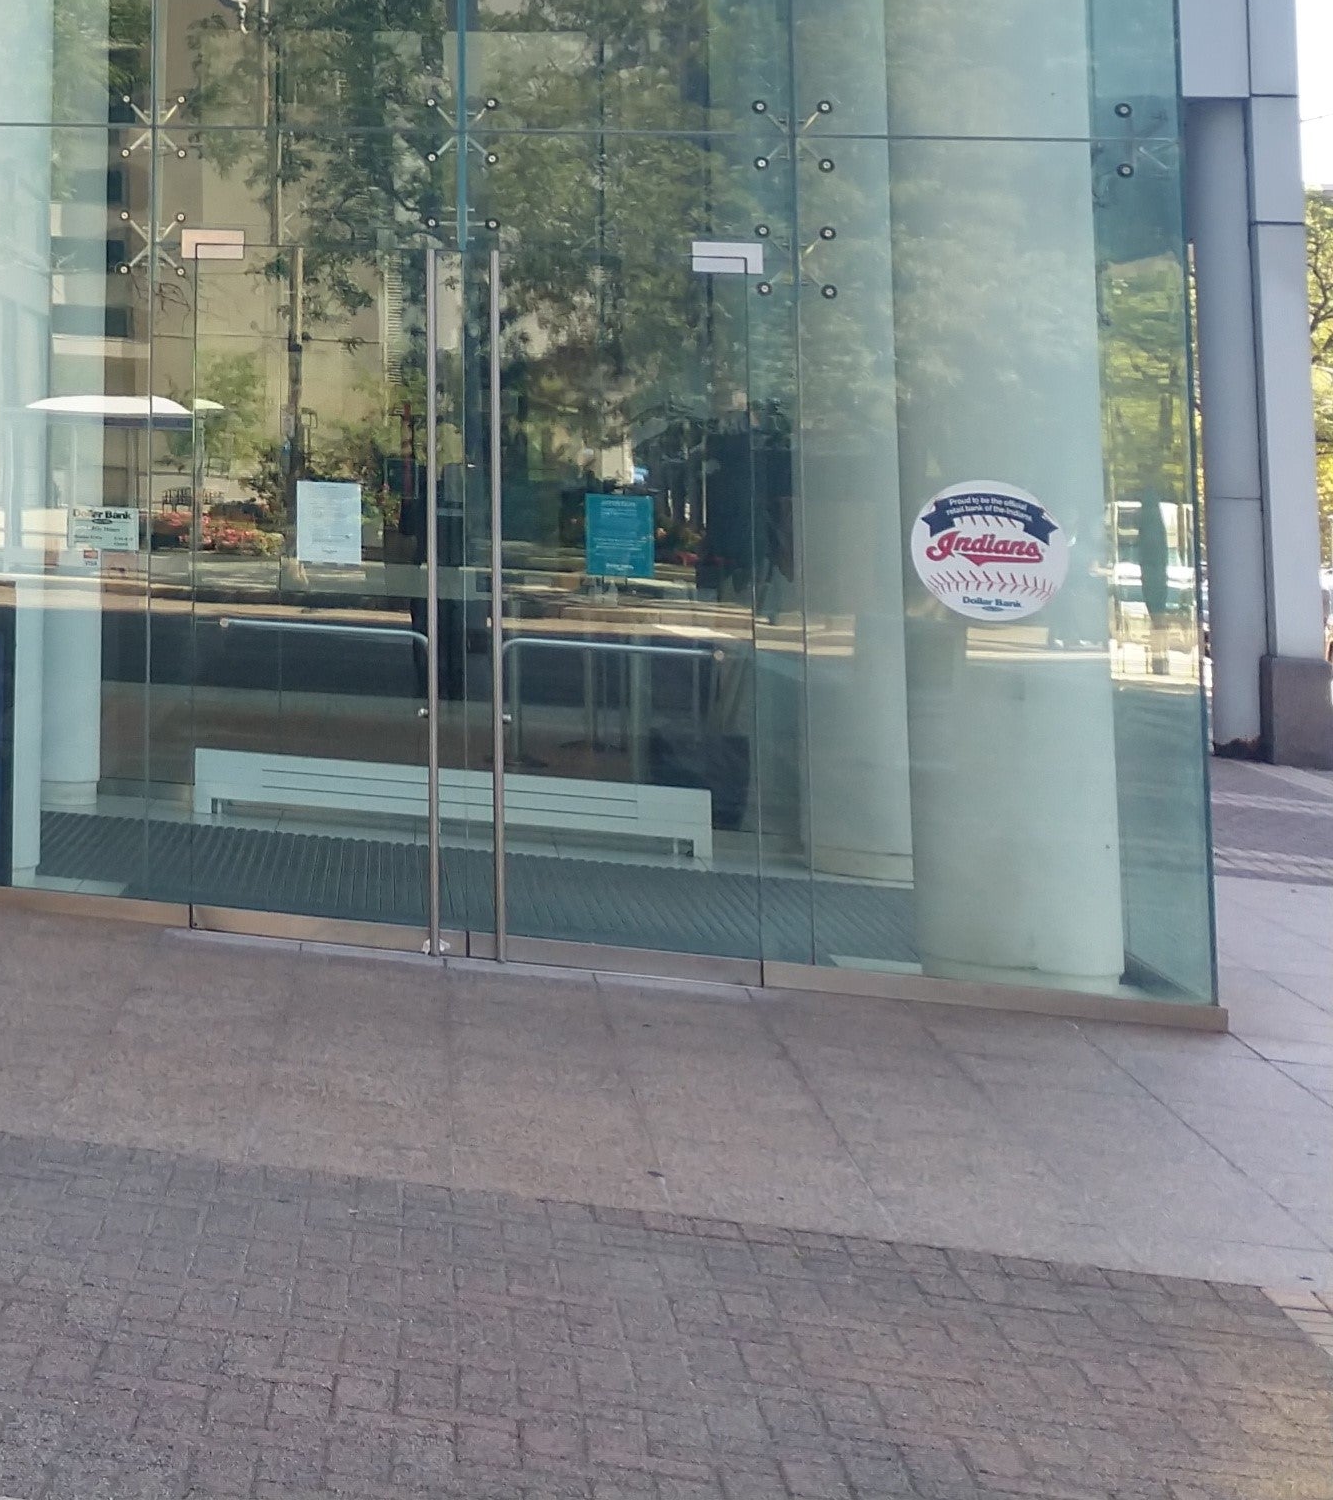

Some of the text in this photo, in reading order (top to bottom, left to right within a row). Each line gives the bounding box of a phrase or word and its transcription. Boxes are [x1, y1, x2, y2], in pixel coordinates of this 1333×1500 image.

[949, 497, 971, 506] Proud
[104, 511, 132, 519] Bank
[925, 531, 1044, 566] Indians
[963, 596, 1021, 607] Dollar Bank
